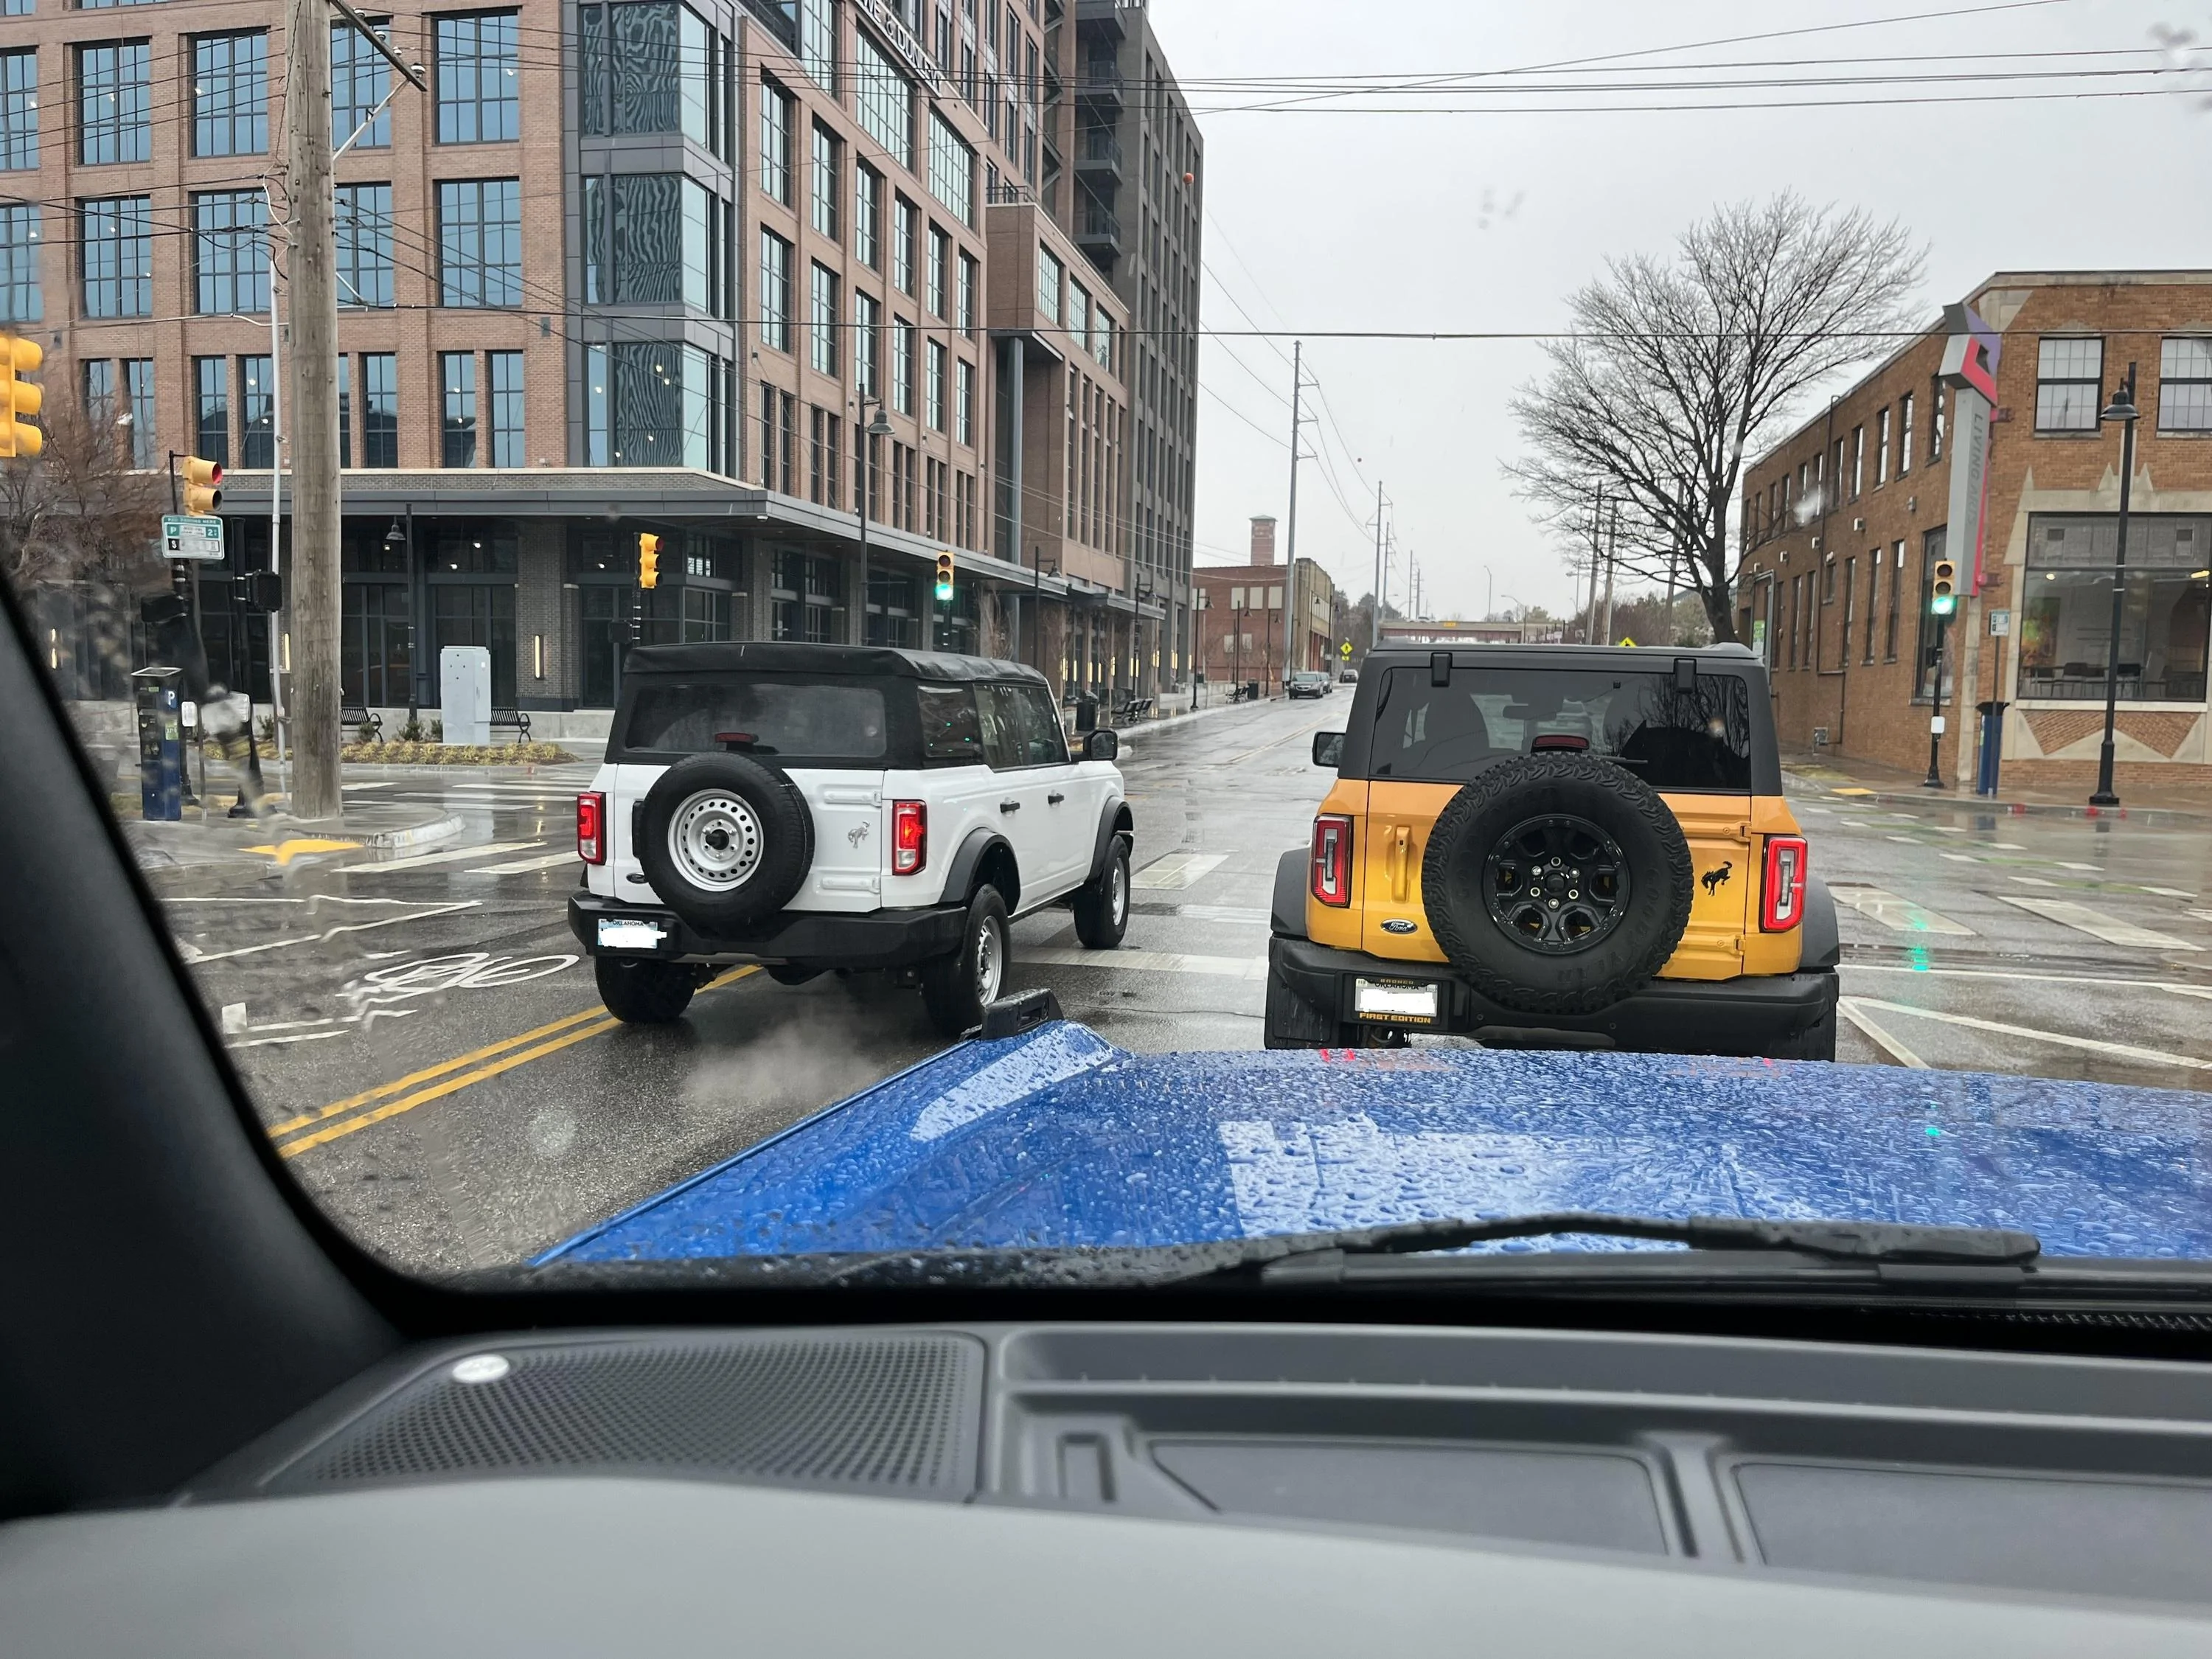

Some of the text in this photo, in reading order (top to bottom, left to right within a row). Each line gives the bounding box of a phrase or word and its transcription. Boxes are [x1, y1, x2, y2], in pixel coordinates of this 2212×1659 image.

[1970, 412, 1984, 481] LIVING
[1360, 1012, 1431, 1023] FIRST EDITION
